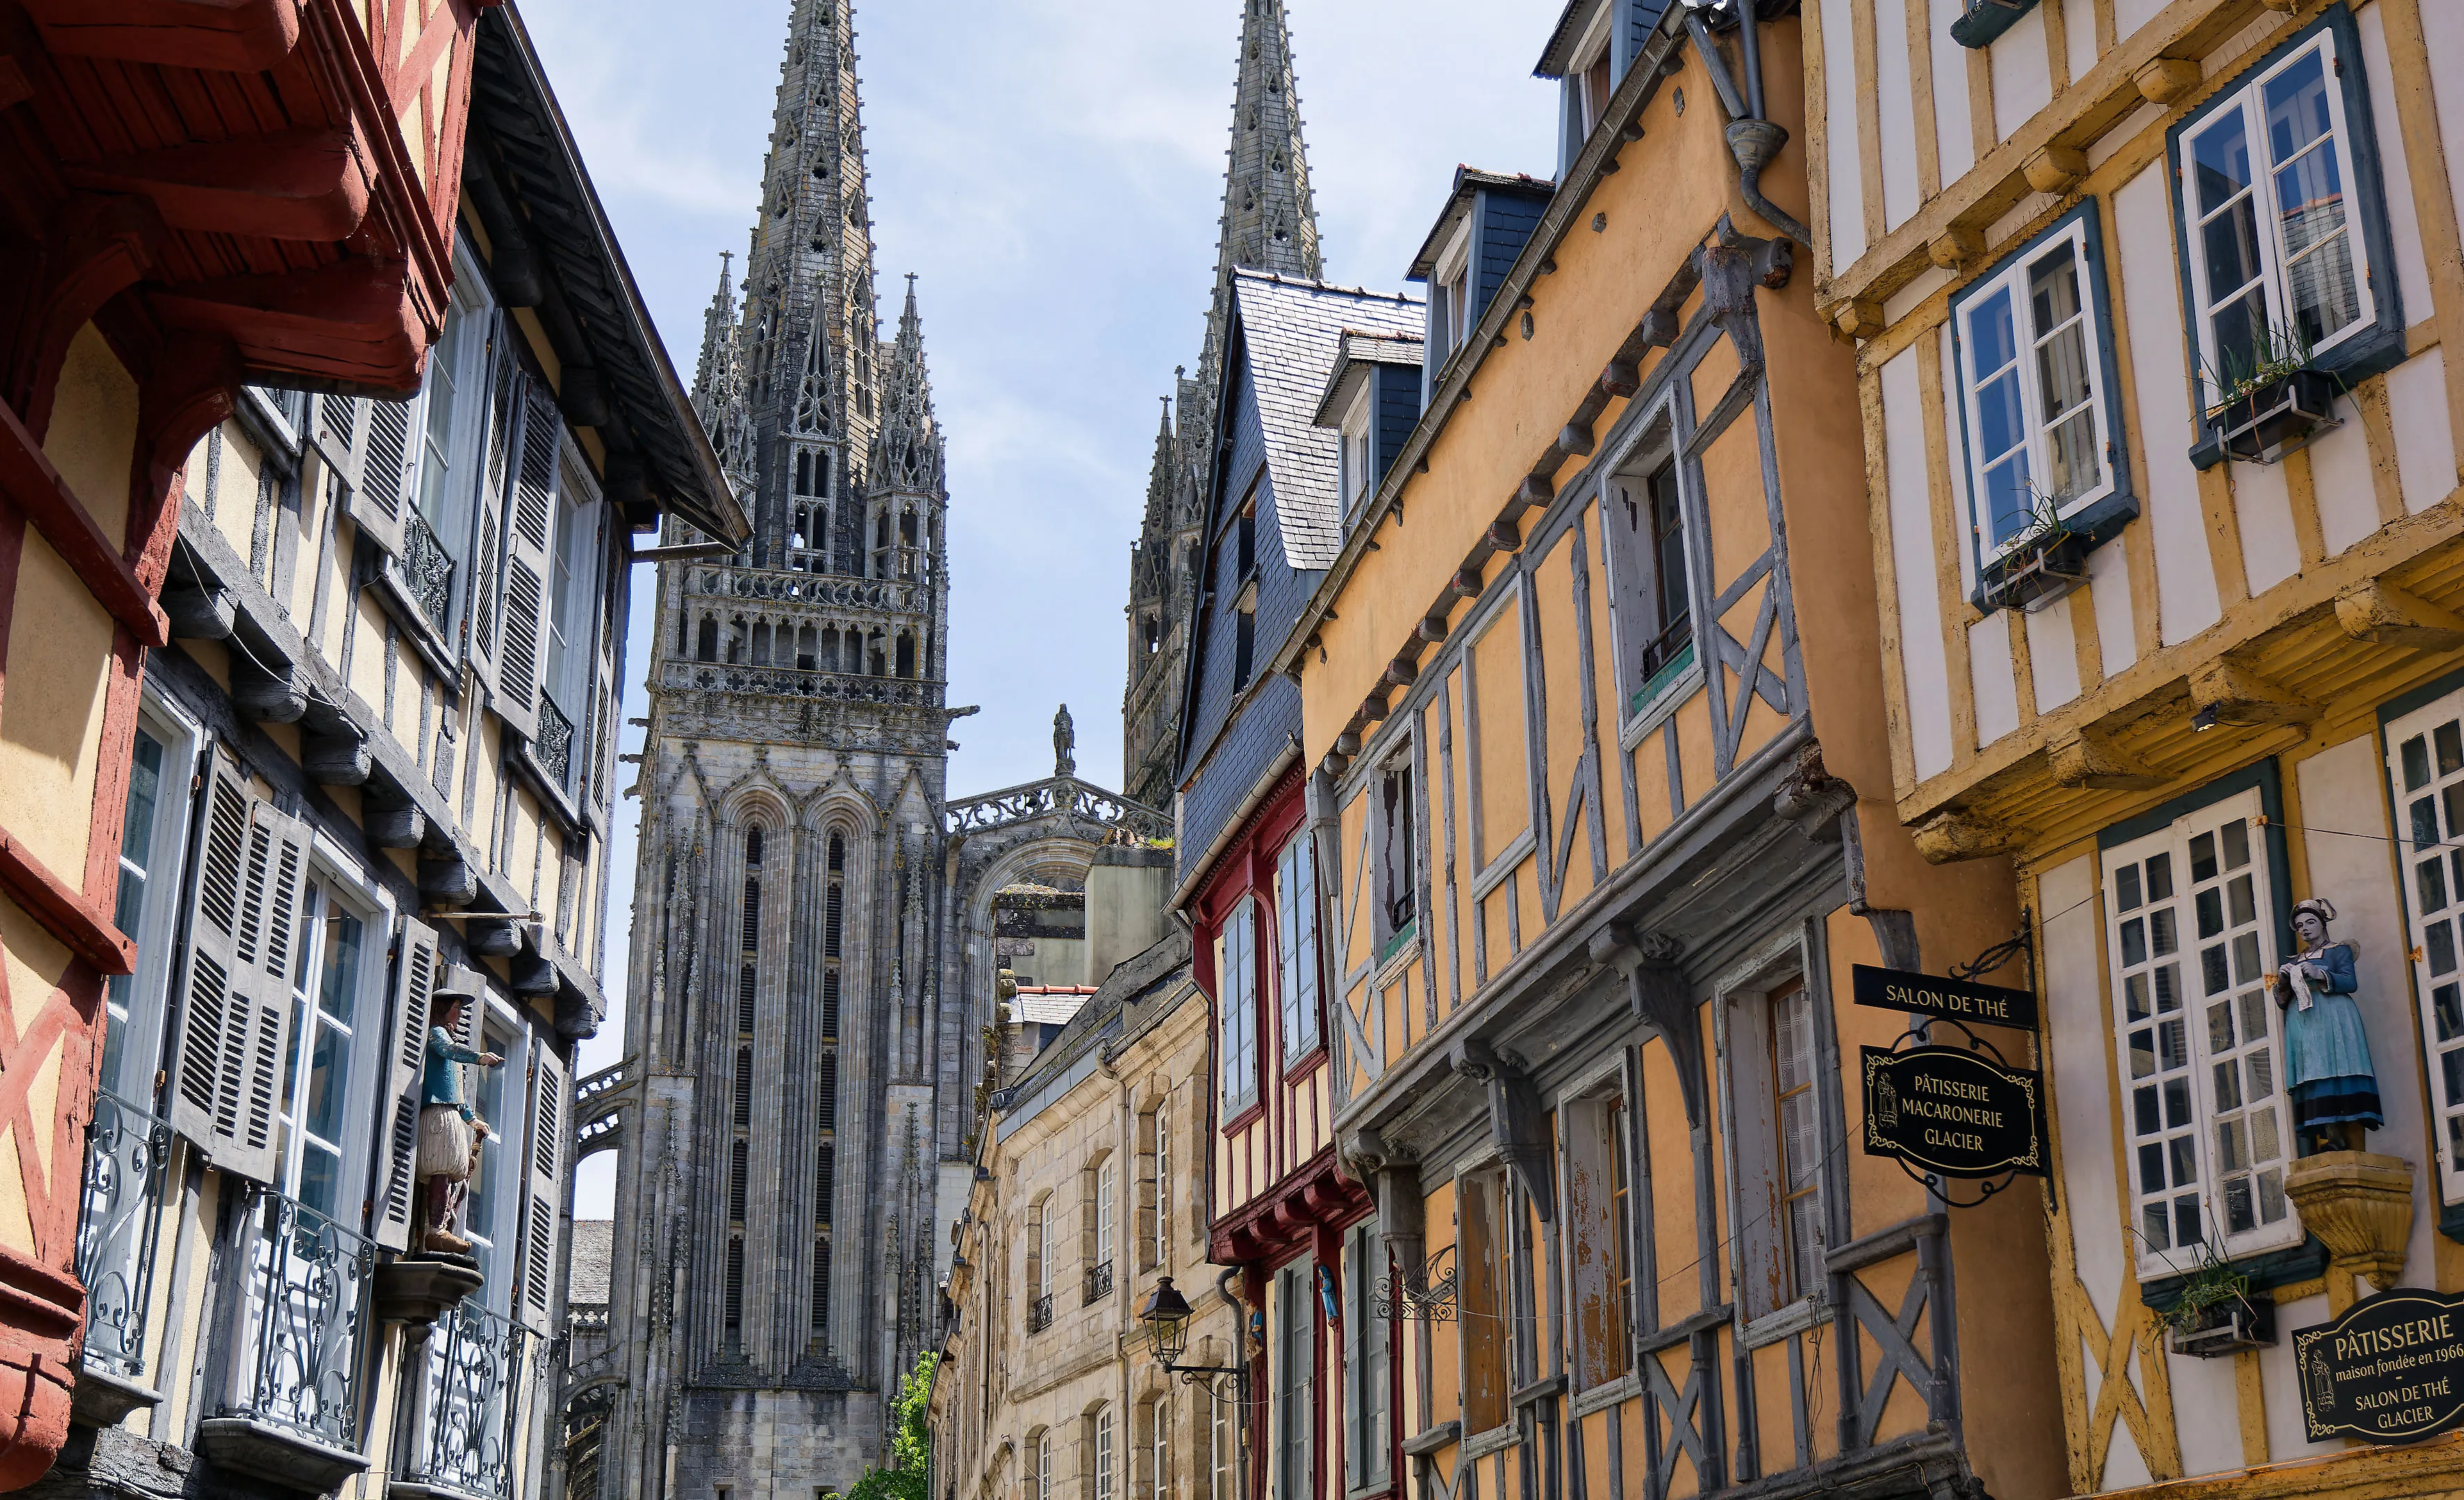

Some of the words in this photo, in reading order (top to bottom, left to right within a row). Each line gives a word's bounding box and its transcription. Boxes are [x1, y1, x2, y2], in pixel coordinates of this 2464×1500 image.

[1886, 985, 1944, 1008] SALON
[1949, 994, 1972, 1012] DE
[1974, 996, 2010, 1018] THÉ
[1915, 1073, 1990, 1102] PÂTISSERIE
[1902, 1098, 2004, 1128] MACARONERIE
[1924, 1128, 1984, 1151] GLACIER
[2335, 1314, 2454, 1360] PÂTISSERIE
[2335, 1364, 2376, 1382] maison
[2376, 1353, 2416, 1377] fondée
[2418, 1353, 2433, 1365] en
[2434, 1343, 2464, 1362] 1966
[2355, 1389, 2399, 1411] SALON
[2401, 1385, 2422, 1402] DE
[2422, 1376, 2451, 1398] THÉ
[2377, 1406, 2434, 1428] GLACIER
